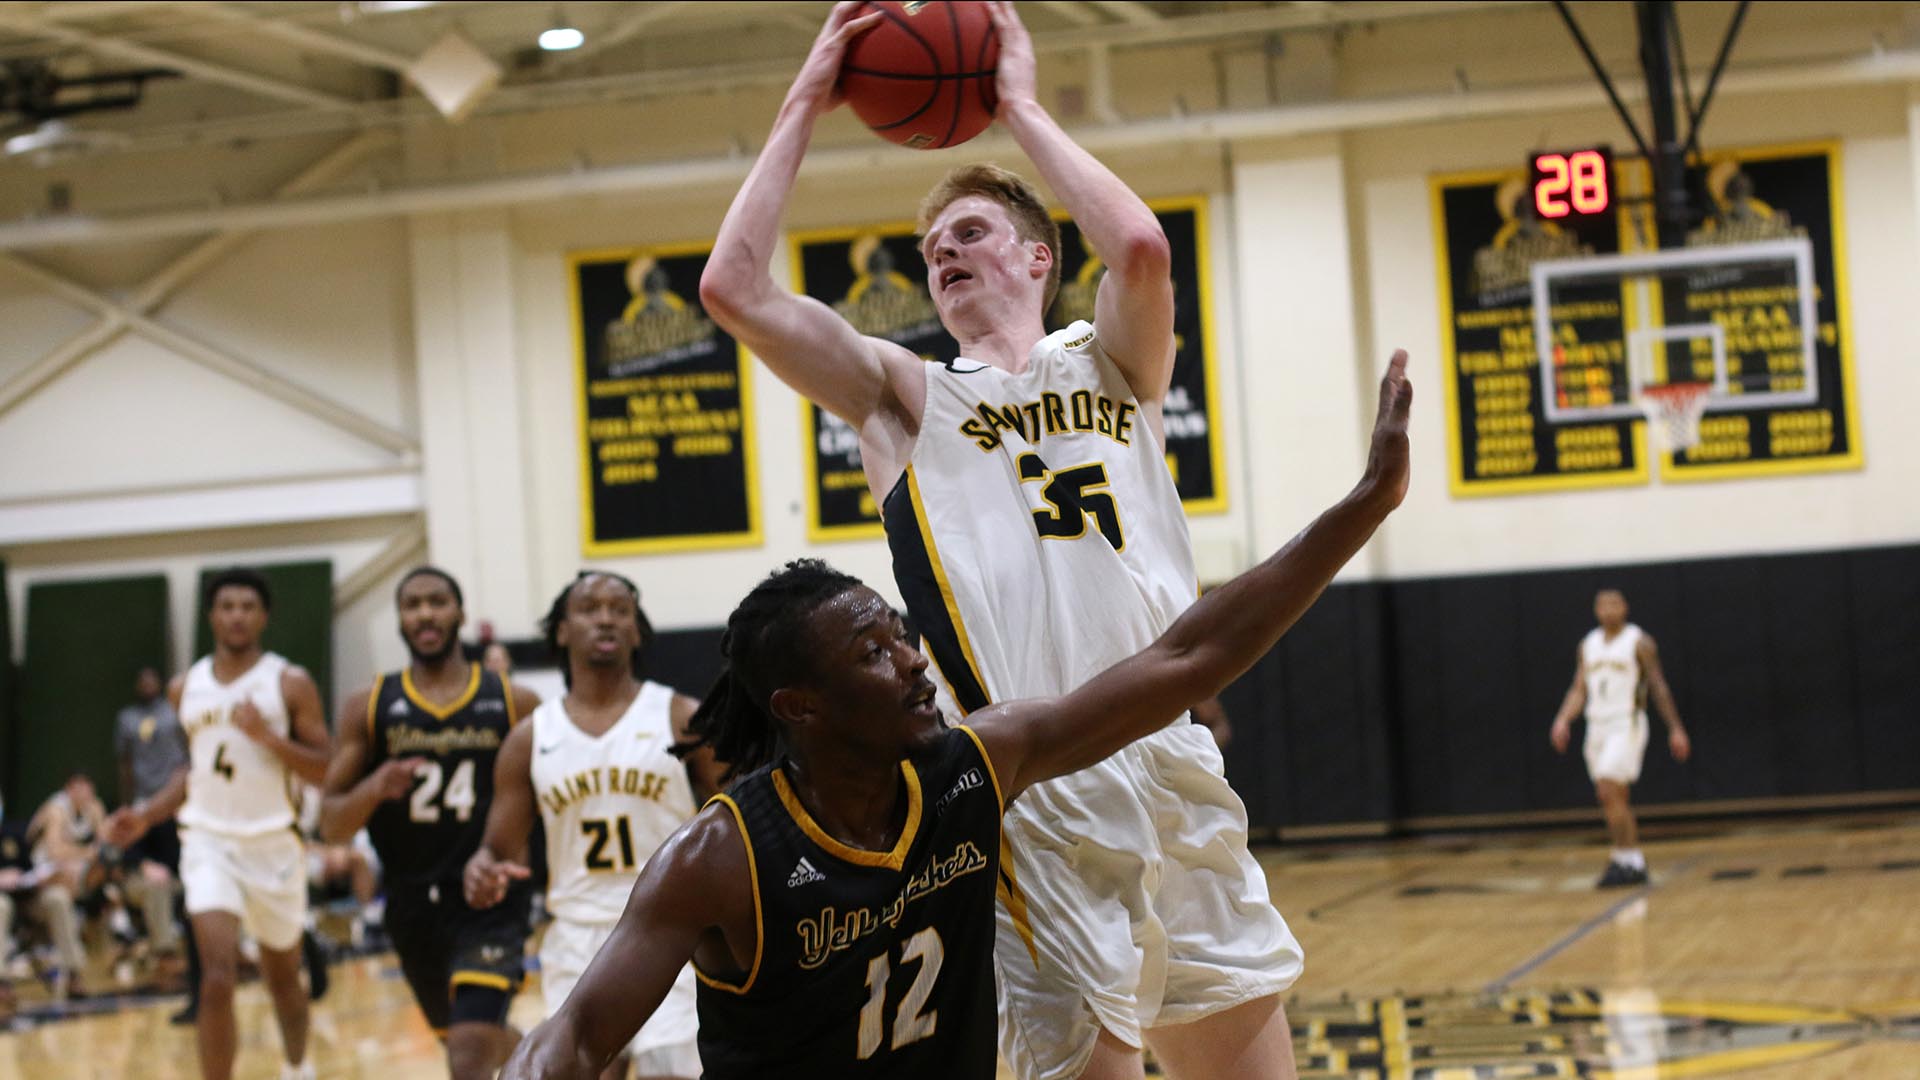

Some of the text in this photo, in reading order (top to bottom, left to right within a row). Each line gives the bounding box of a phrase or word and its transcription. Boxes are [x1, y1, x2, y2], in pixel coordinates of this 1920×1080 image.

[1535, 150, 1609, 218] 28
[1500, 325, 1577, 350] NCA
[1016, 451, 1128, 554] 35
[213, 741, 236, 784] 4
[409, 758, 477, 824] 24
[608, 766, 670, 802] ROSE
[580, 811, 637, 873] 21
[856, 925, 945, 1061] 12
